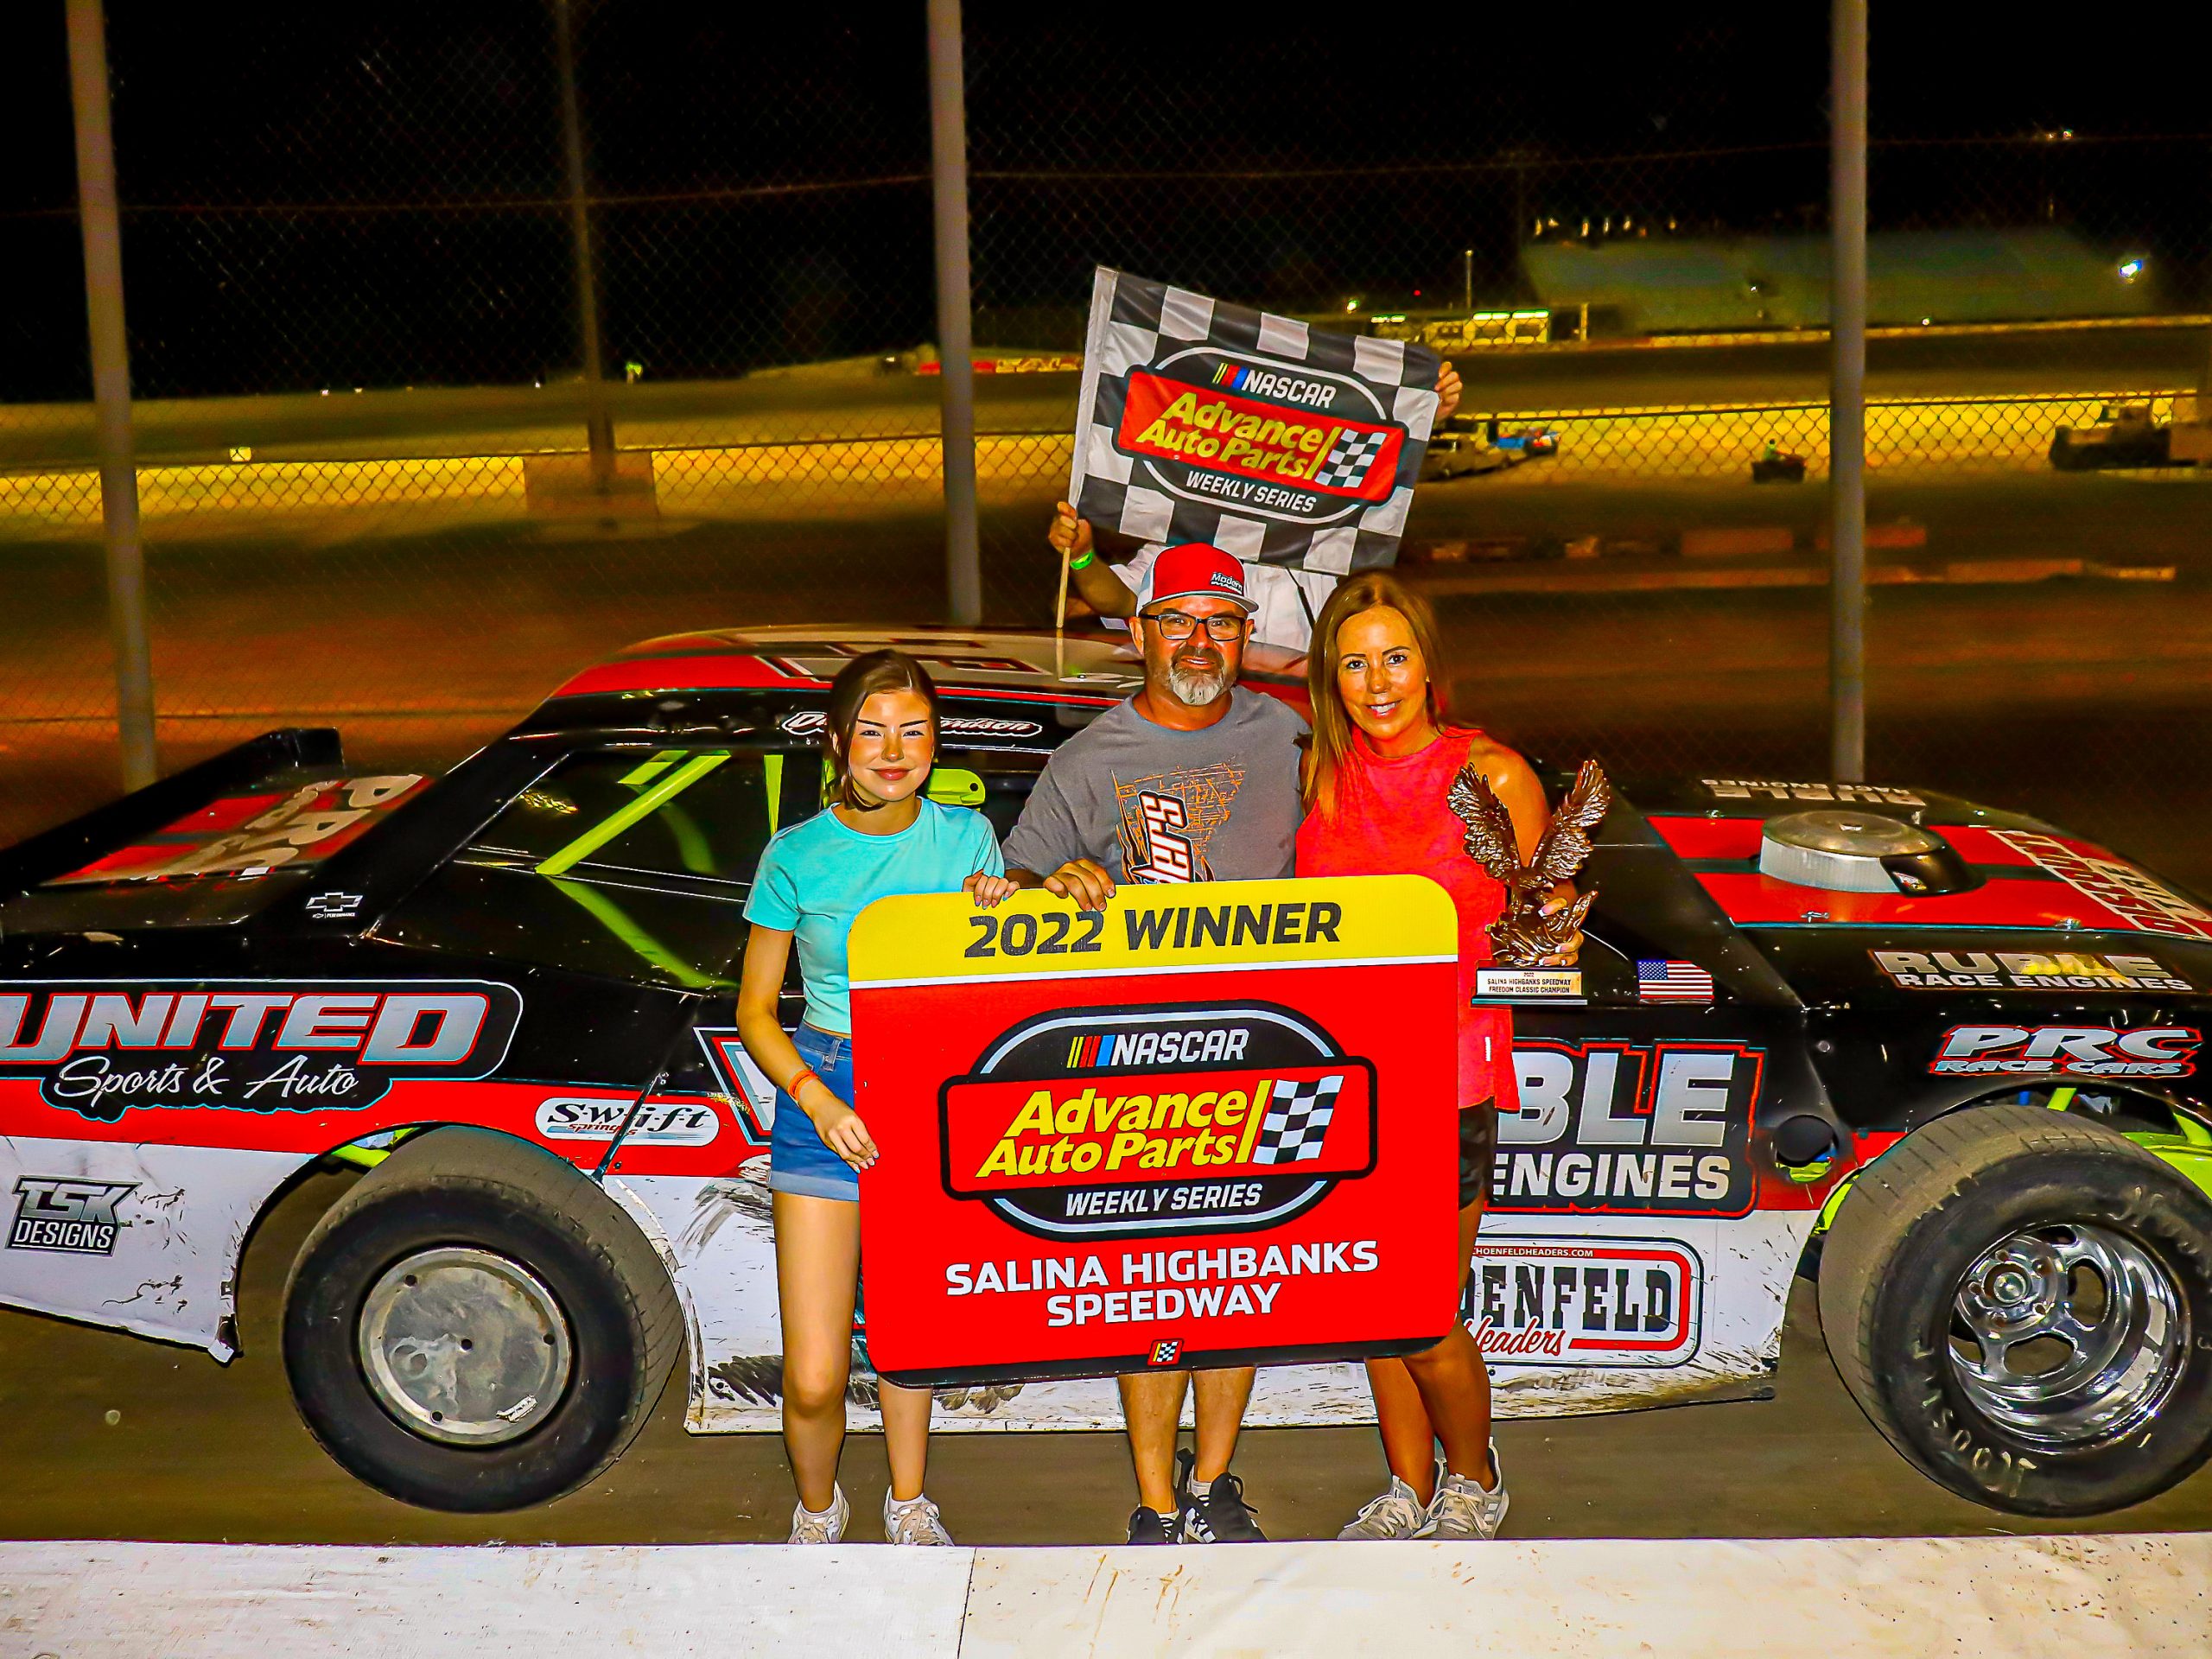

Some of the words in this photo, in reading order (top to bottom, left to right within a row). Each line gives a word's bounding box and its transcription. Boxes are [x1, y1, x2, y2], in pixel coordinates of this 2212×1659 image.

[1242, 369, 1337, 408] NASCAR
[1161, 392, 1324, 453] Advance
[1135, 420, 1220, 458] Auto
[1218, 437, 1308, 477] Parts
[1186, 471, 1255, 499] WEEKLY
[1254, 486, 1317, 512] SERIES
[1211, 572, 1243, 591] Modern
[964, 910, 1105, 957] 2022
[1124, 902, 1343, 950] WINNER
[1898, 974, 2004, 987] RACE
[2010, 975, 2194, 991] ENGINES
[0, 994, 488, 1064] UNITED
[1110, 1028, 1249, 1066] NASCAR
[1942, 1028, 2192, 1062] PRC
[55, 1055, 185, 1107] Sports
[194, 1057, 229, 1095] &
[245, 1054, 359, 1098] Auto
[1934, 1060, 2054, 1073] RACE
[2066, 1061, 2182, 1075] CARS
[1003, 1086, 1248, 1137] Advance
[975, 1134, 1109, 1179] Auto
[1104, 1128, 1237, 1171] Parts
[16, 1179, 132, 1224] TSK
[1065, 1187, 1172, 1217] WEEKLY
[1171, 1182, 1264, 1211] SERIES
[14, 1219, 114, 1249] DESIGNS
[944, 1255, 1110, 1296] SALINA
[1122, 1239, 1380, 1285] HIGHBANKS
[1046, 1282, 1282, 1326] SPEEDWAY
